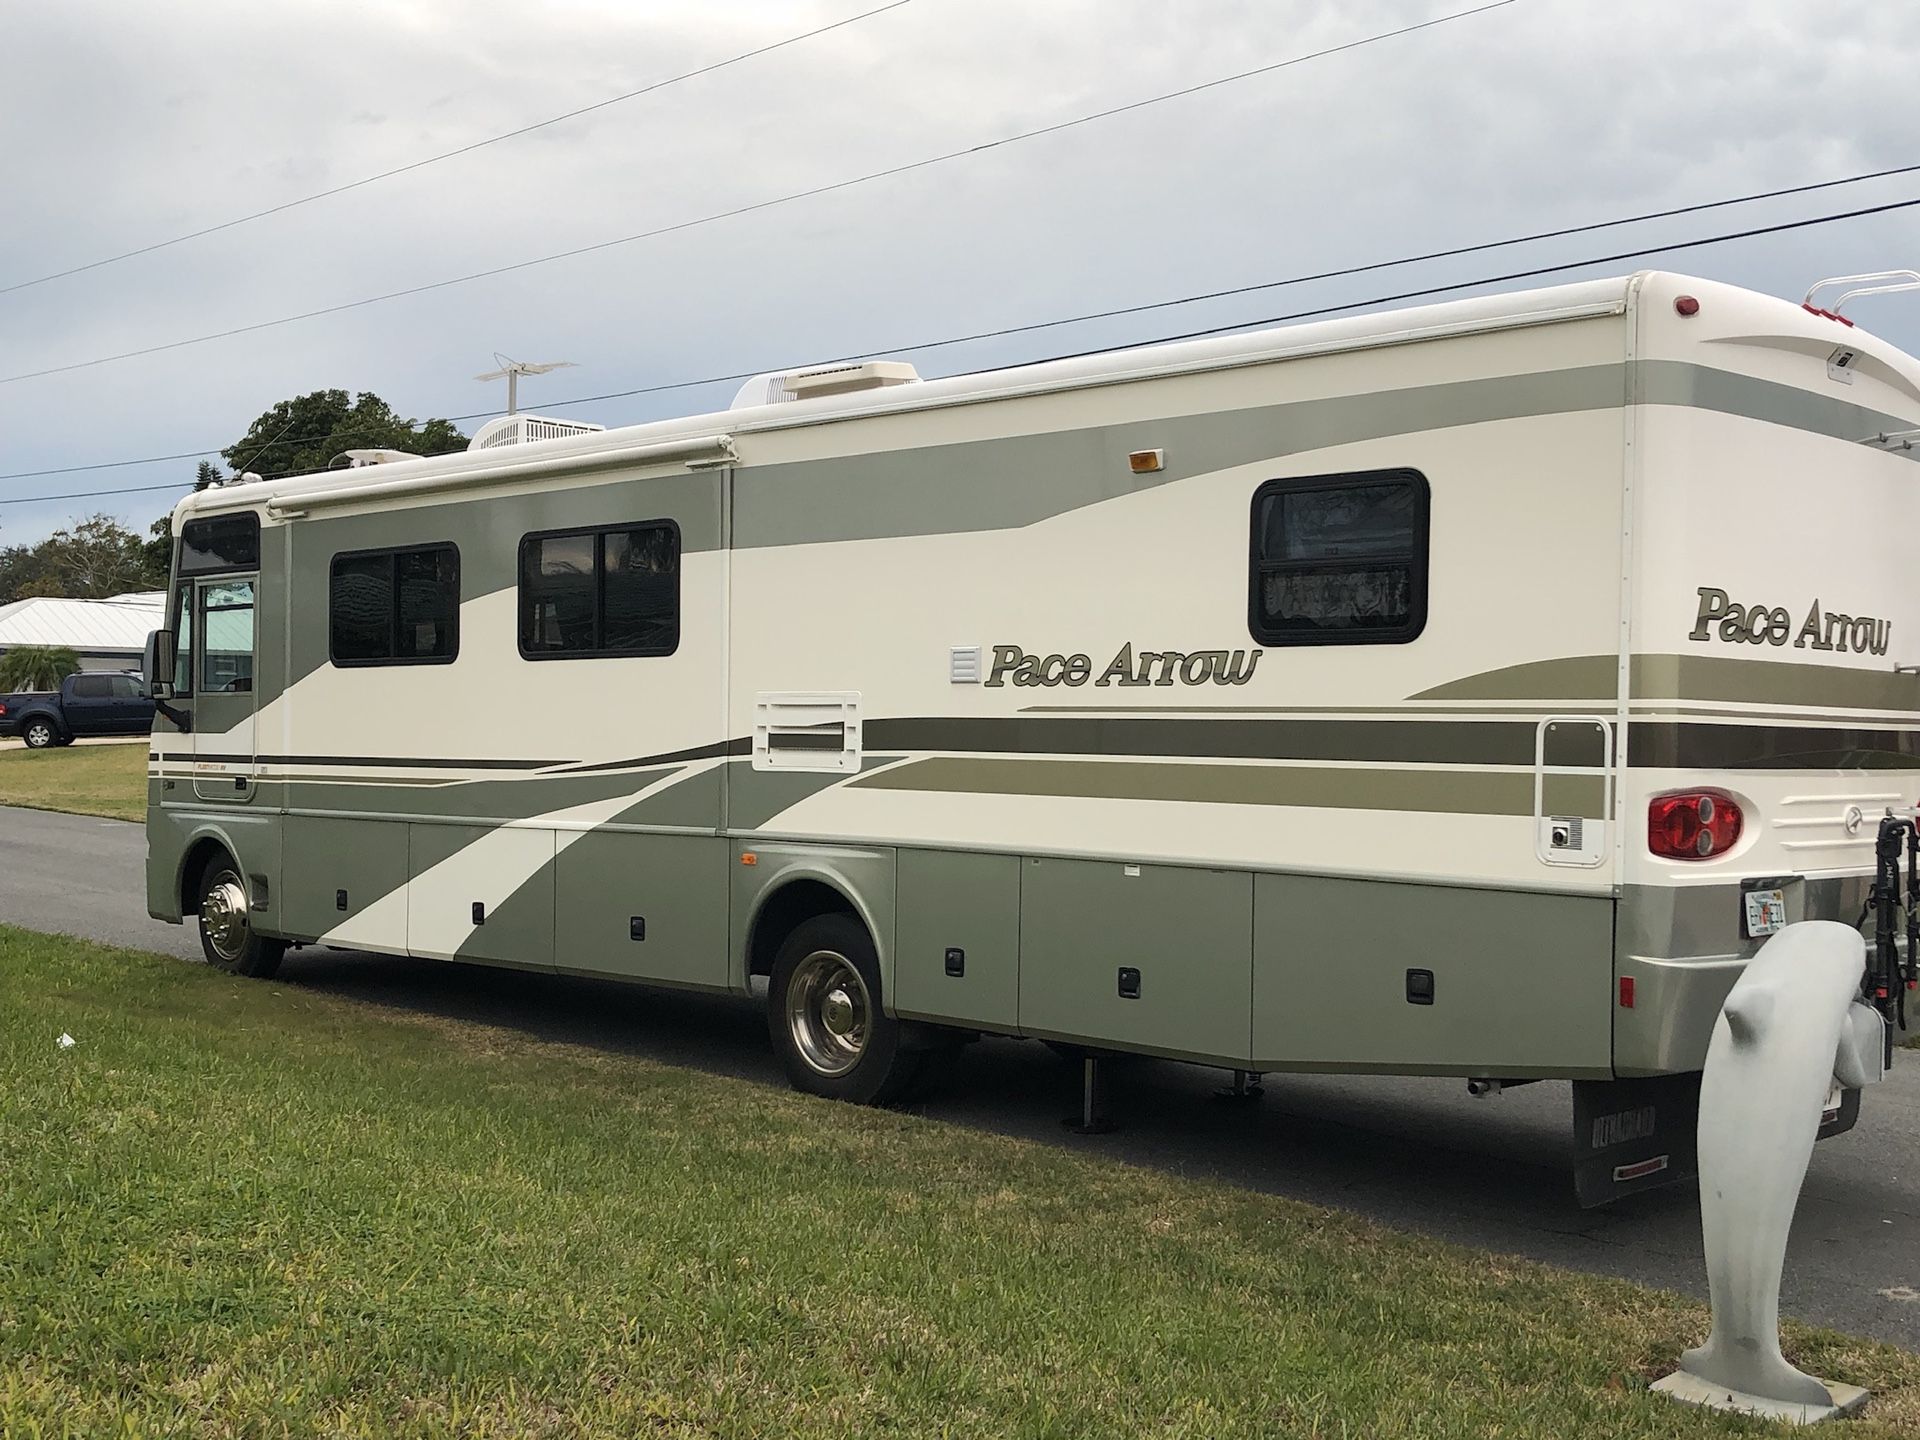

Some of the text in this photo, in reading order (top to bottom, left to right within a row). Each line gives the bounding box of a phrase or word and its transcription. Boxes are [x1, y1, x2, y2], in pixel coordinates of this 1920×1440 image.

[1689, 587, 1891, 656] Pace Arrow
[984, 641, 1263, 687] Pace Arrow
